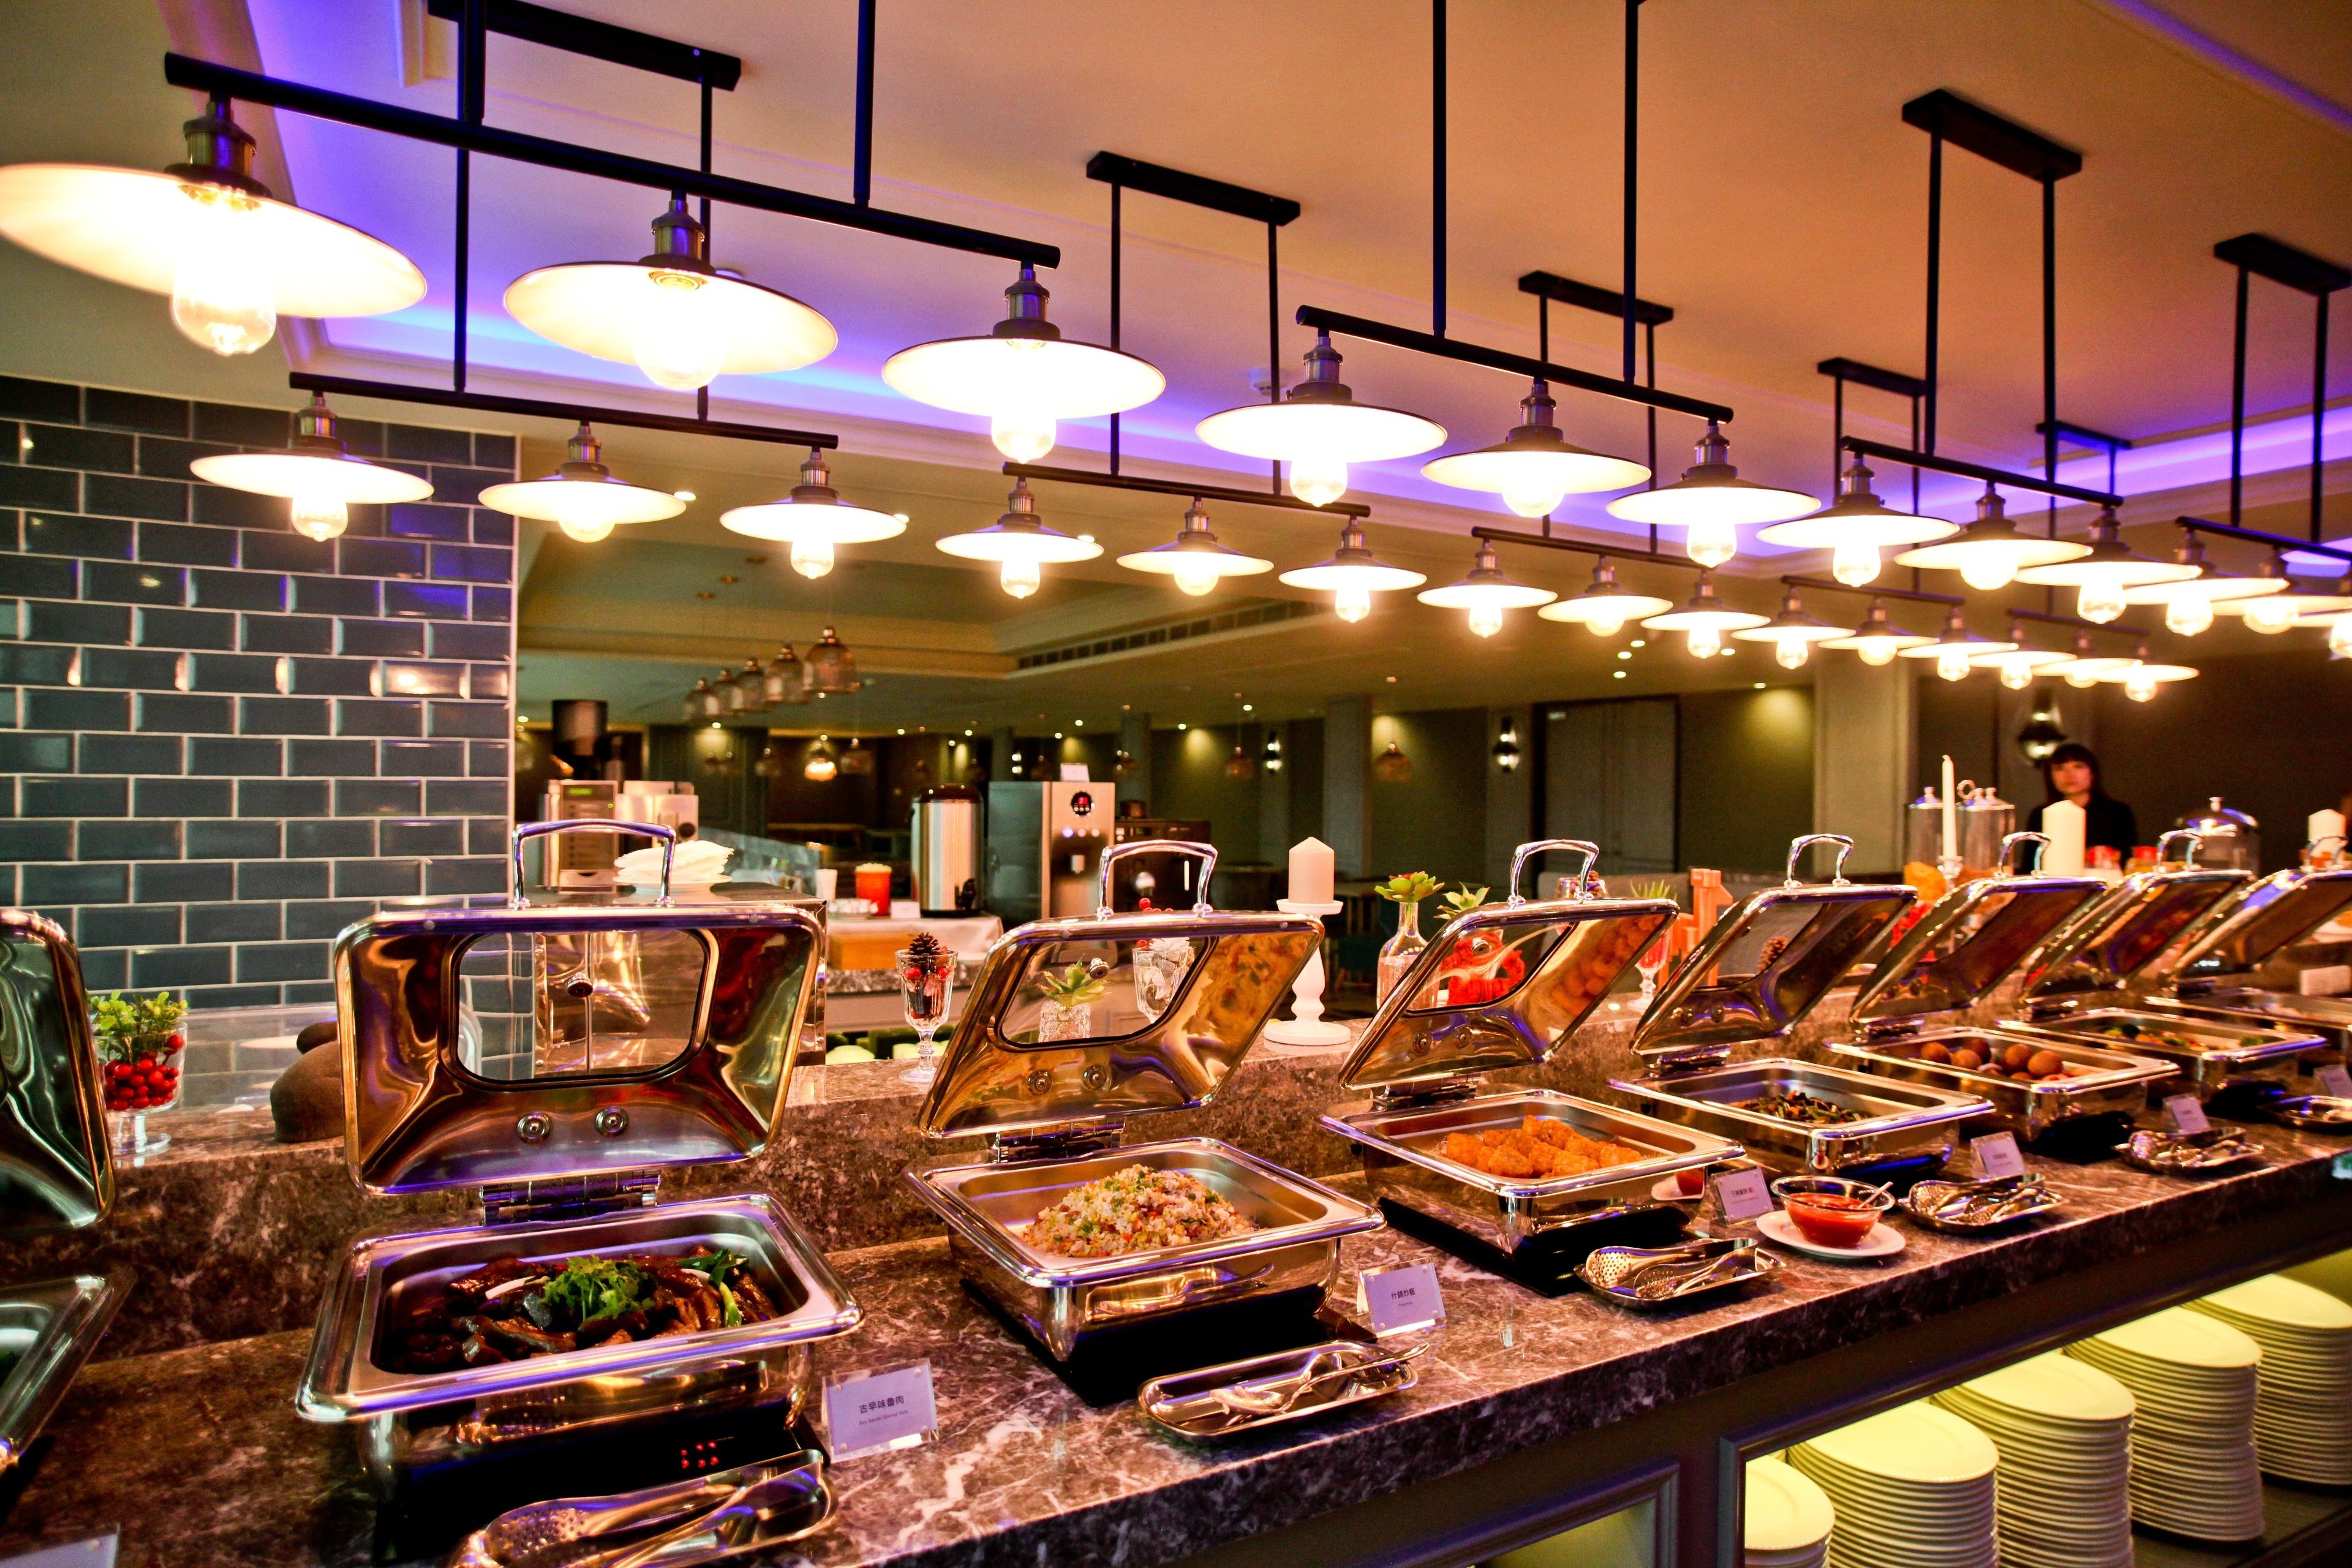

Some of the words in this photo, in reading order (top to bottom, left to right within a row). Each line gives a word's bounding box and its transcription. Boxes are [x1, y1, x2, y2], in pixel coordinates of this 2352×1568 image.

[1391, 1287, 1415, 1300] 什錦炒飯
[859, 1395, 904, 1414] 古早味魯肉
